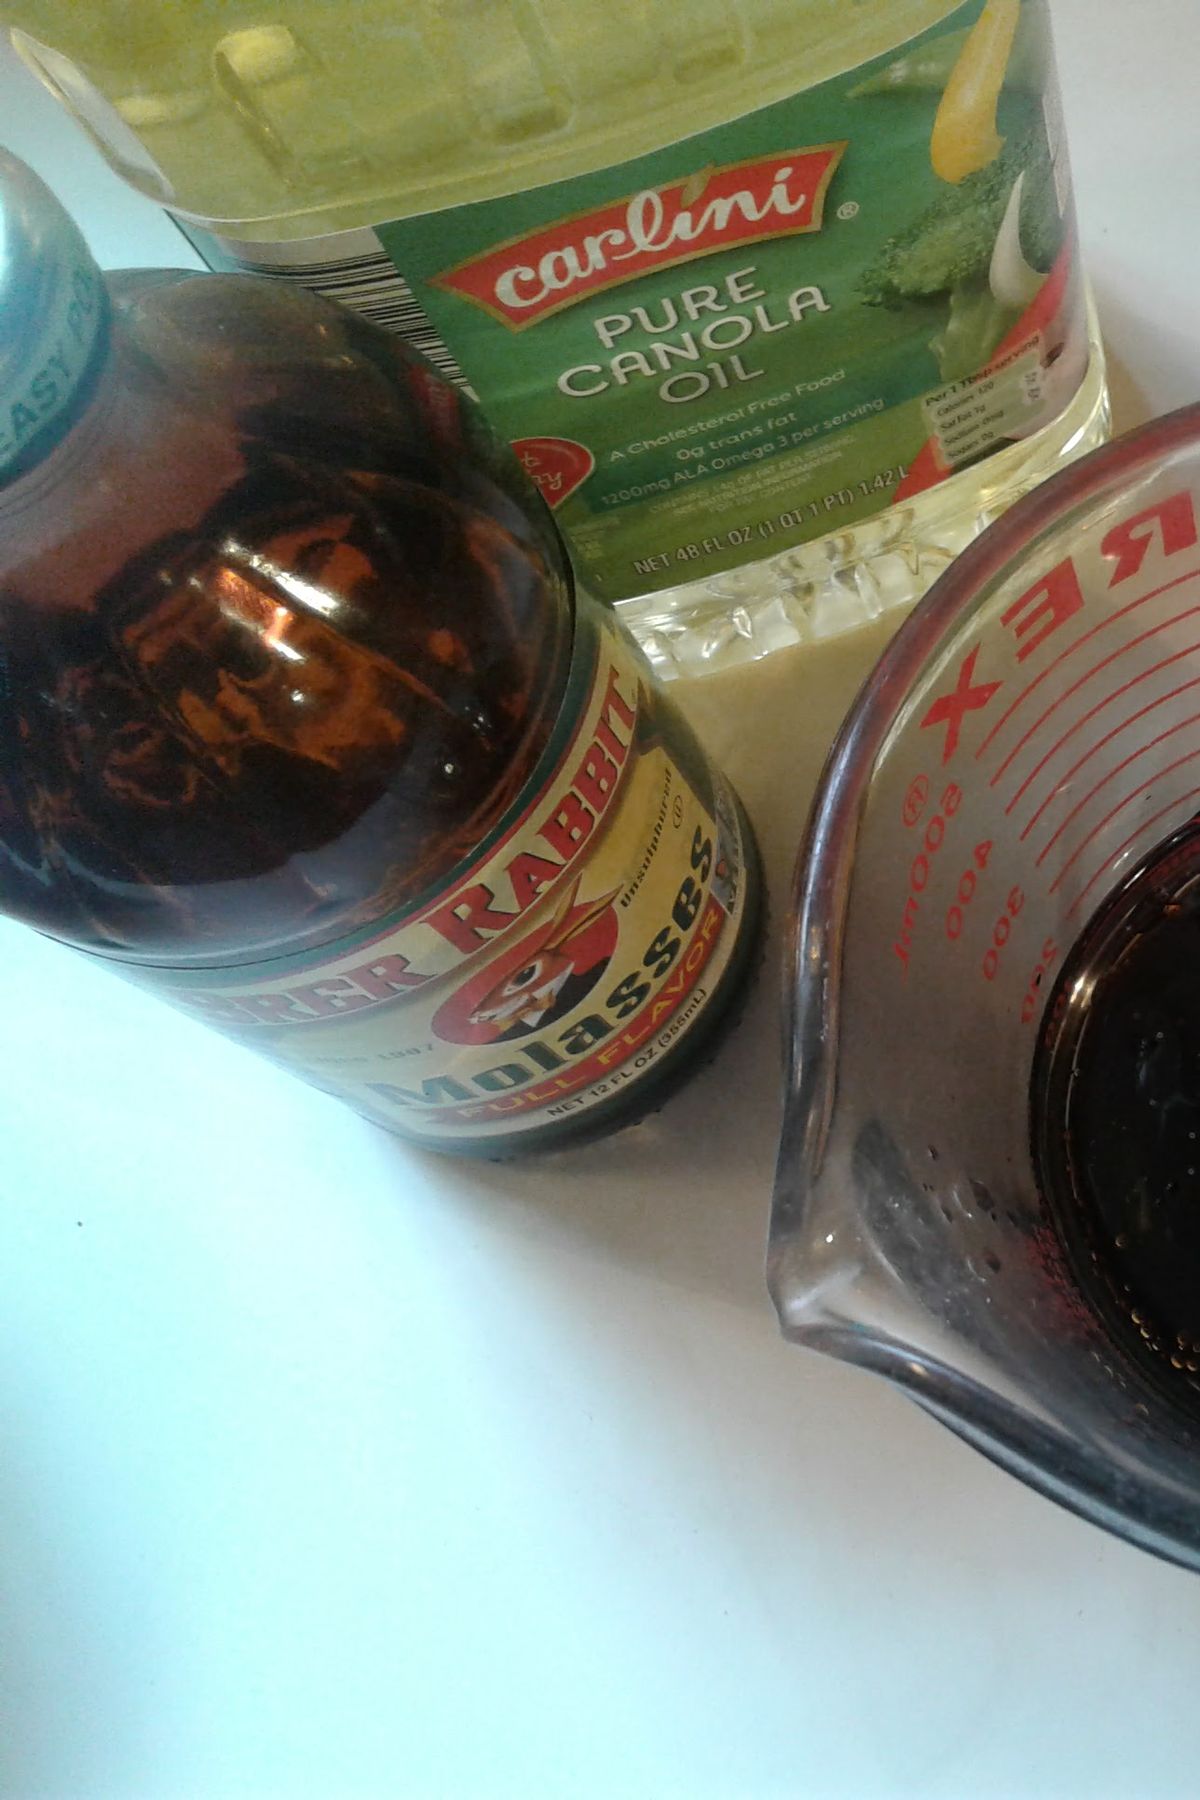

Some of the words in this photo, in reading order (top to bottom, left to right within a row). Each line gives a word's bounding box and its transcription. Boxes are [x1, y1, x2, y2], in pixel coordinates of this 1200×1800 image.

[495, 166, 806, 307] carlini
[557, 286, 831, 397] CANOLA
[593, 266, 767, 349] PURE
[609, 449, 626, 463] A
[627, 409, 745, 453] Cholesterol
[747, 391, 792, 415] Free
[794, 368, 847, 396] Food
[658, 354, 765, 404] OIL
[601, 478, 671, 506] 1200mg
[672, 463, 709, 485] ALA
[711, 443, 775, 471] Omega
[778, 435, 790, 449] 3
[791, 423, 819, 445] per
[823, 397, 885, 430] serving
[676, 445, 705, 462] 0g
[709, 426, 763, 450] trans
[767, 411, 798, 431] fat
[633, 552, 672, 576] NET
[676, 543, 700, 562] 48
[702, 537, 726, 555] FL
[728, 526, 754, 547] OZ
[758, 518, 777, 540] (1
[780, 508, 803, 530] QT
[809, 503, 819, 517] 1
[824, 487, 855, 512] PT)
[858, 470, 894, 498] 1.42
[896, 465, 911, 482] L
[423, 666, 639, 955] RABBIT
[620, 767, 673, 909] Unsulphured
[366, 825, 713, 1106] Molasses
[457, 1069, 586, 1118] FULL
[597, 907, 719, 1066] FLAVOR
[547, 1094, 585, 1118] NET
[590, 1084, 613, 1099] 12
[610, 1065, 634, 1086] FL
[634, 1047, 657, 1070] OZ
